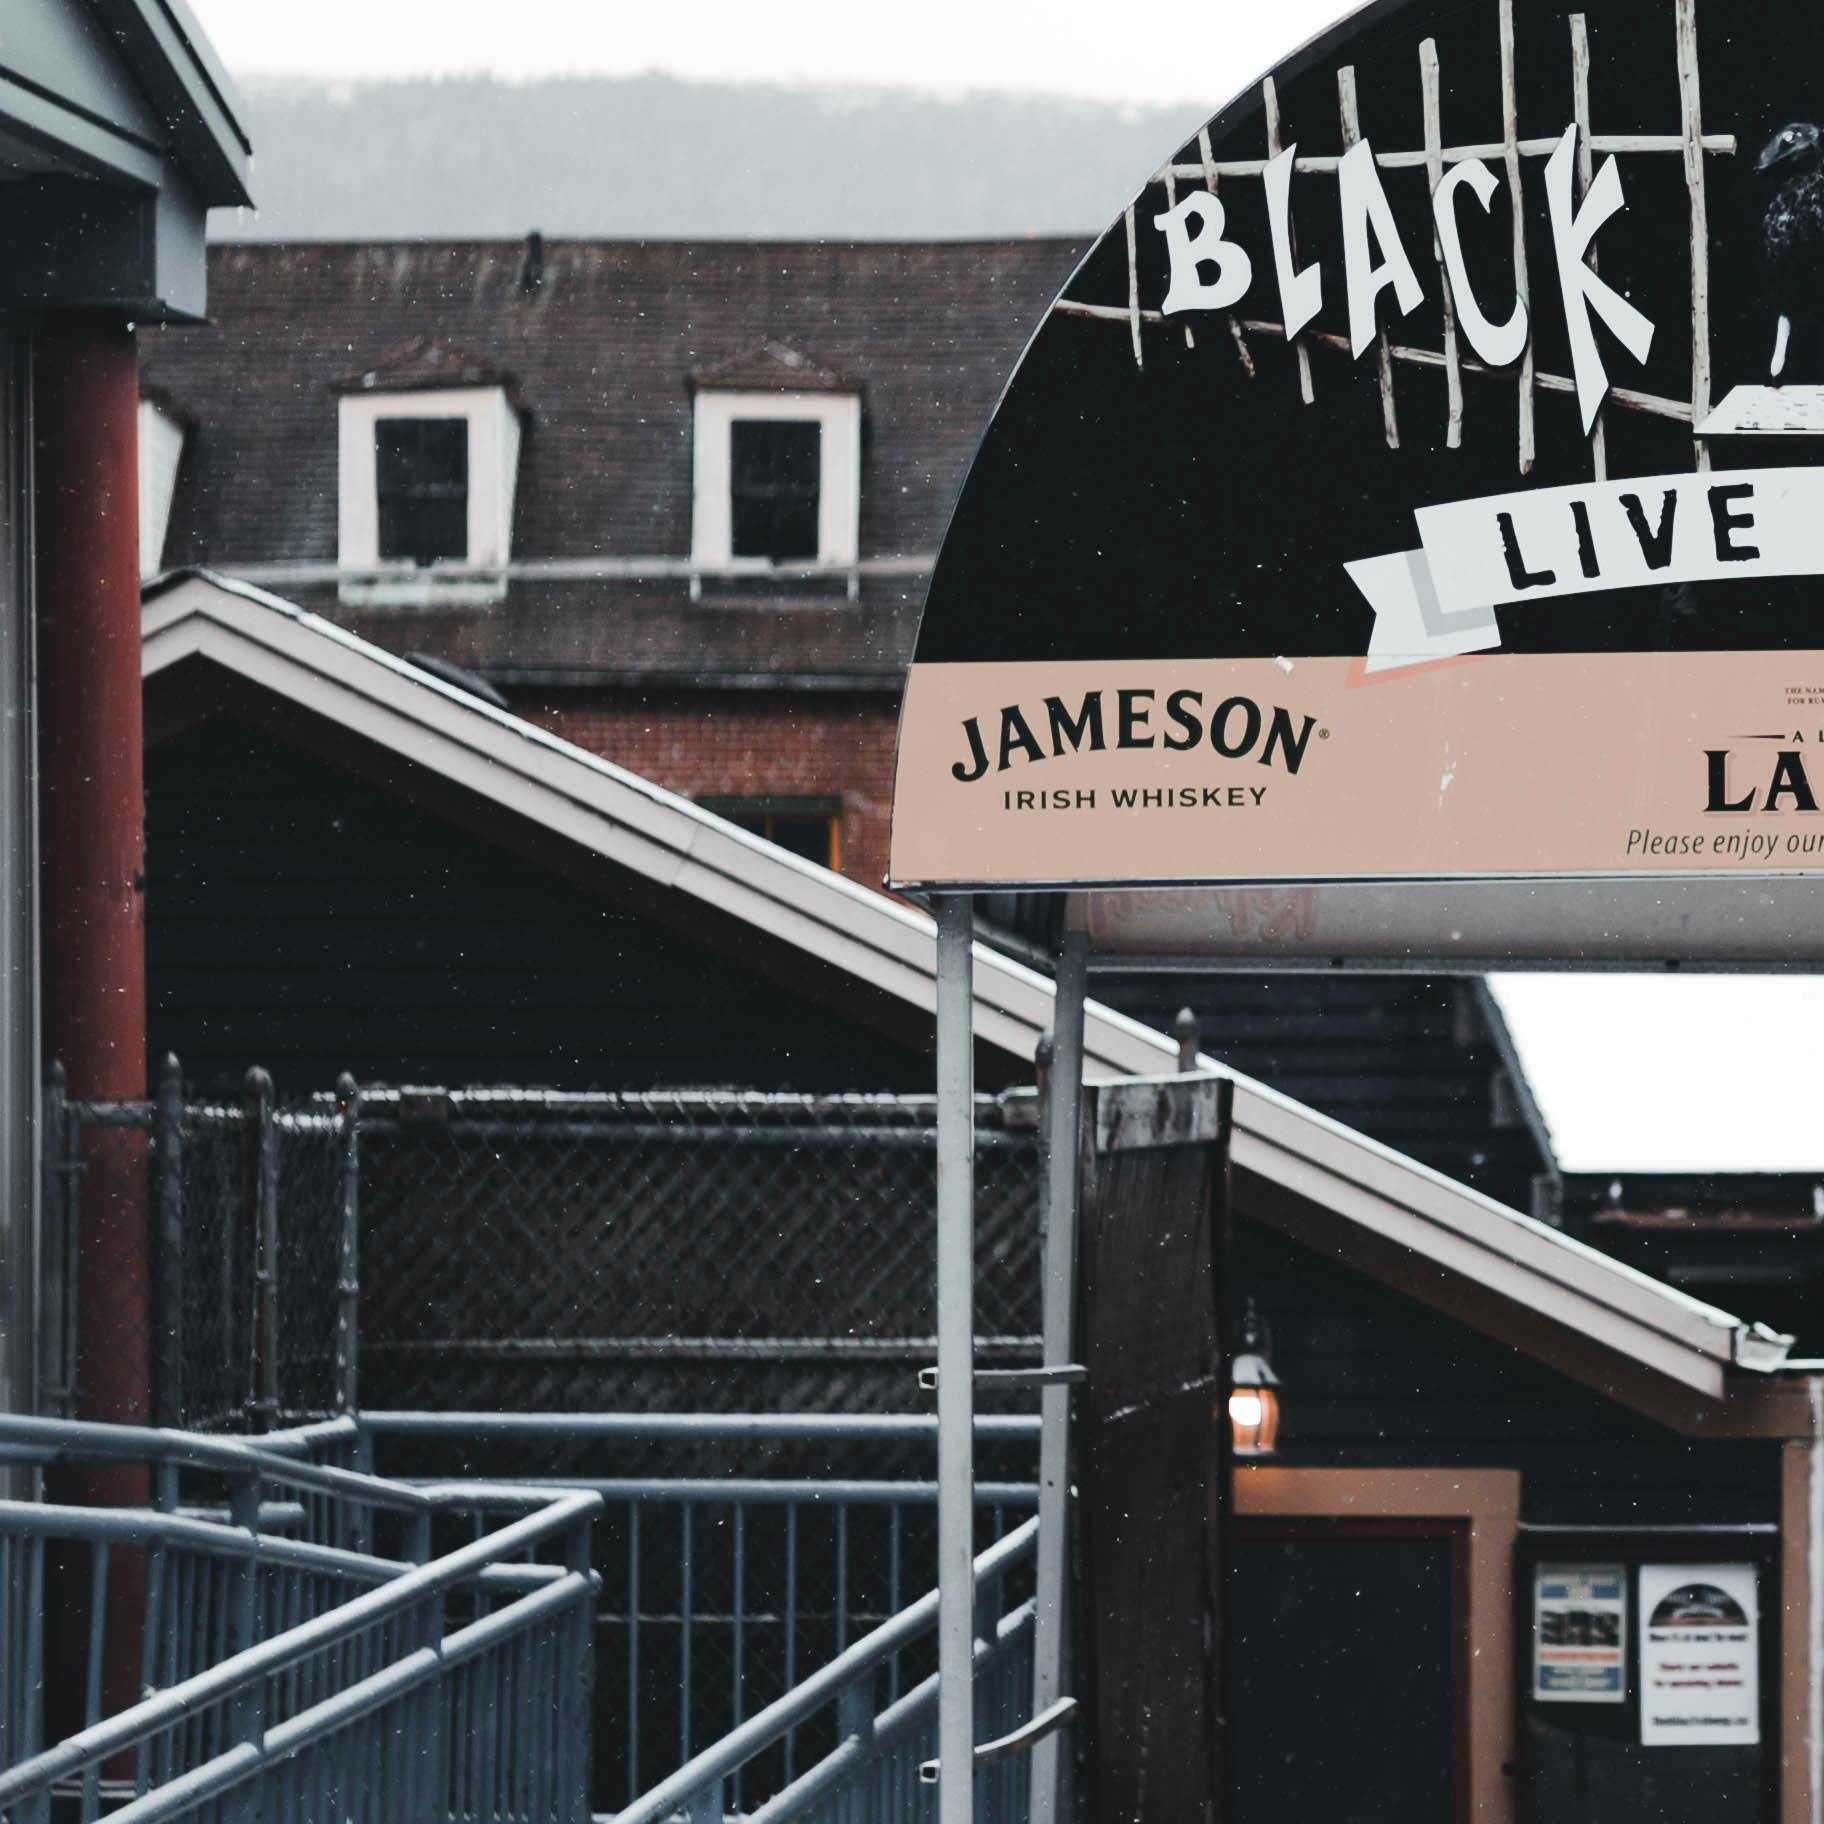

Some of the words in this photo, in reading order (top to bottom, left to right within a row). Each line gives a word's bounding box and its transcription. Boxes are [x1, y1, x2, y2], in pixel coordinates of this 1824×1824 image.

[1153, 122, 1656, 437] BLACK
[1496, 482, 1761, 590] LIVE
[1784, 687, 1801, 695] THE
[1787, 697, 1805, 705] FOR
[1003, 789, 1096, 810] IRISH
[1110, 787, 1268, 808] WHISKEY
[1626, 828, 1705, 855] Please
[1712, 829, 1779, 860] enjoy
